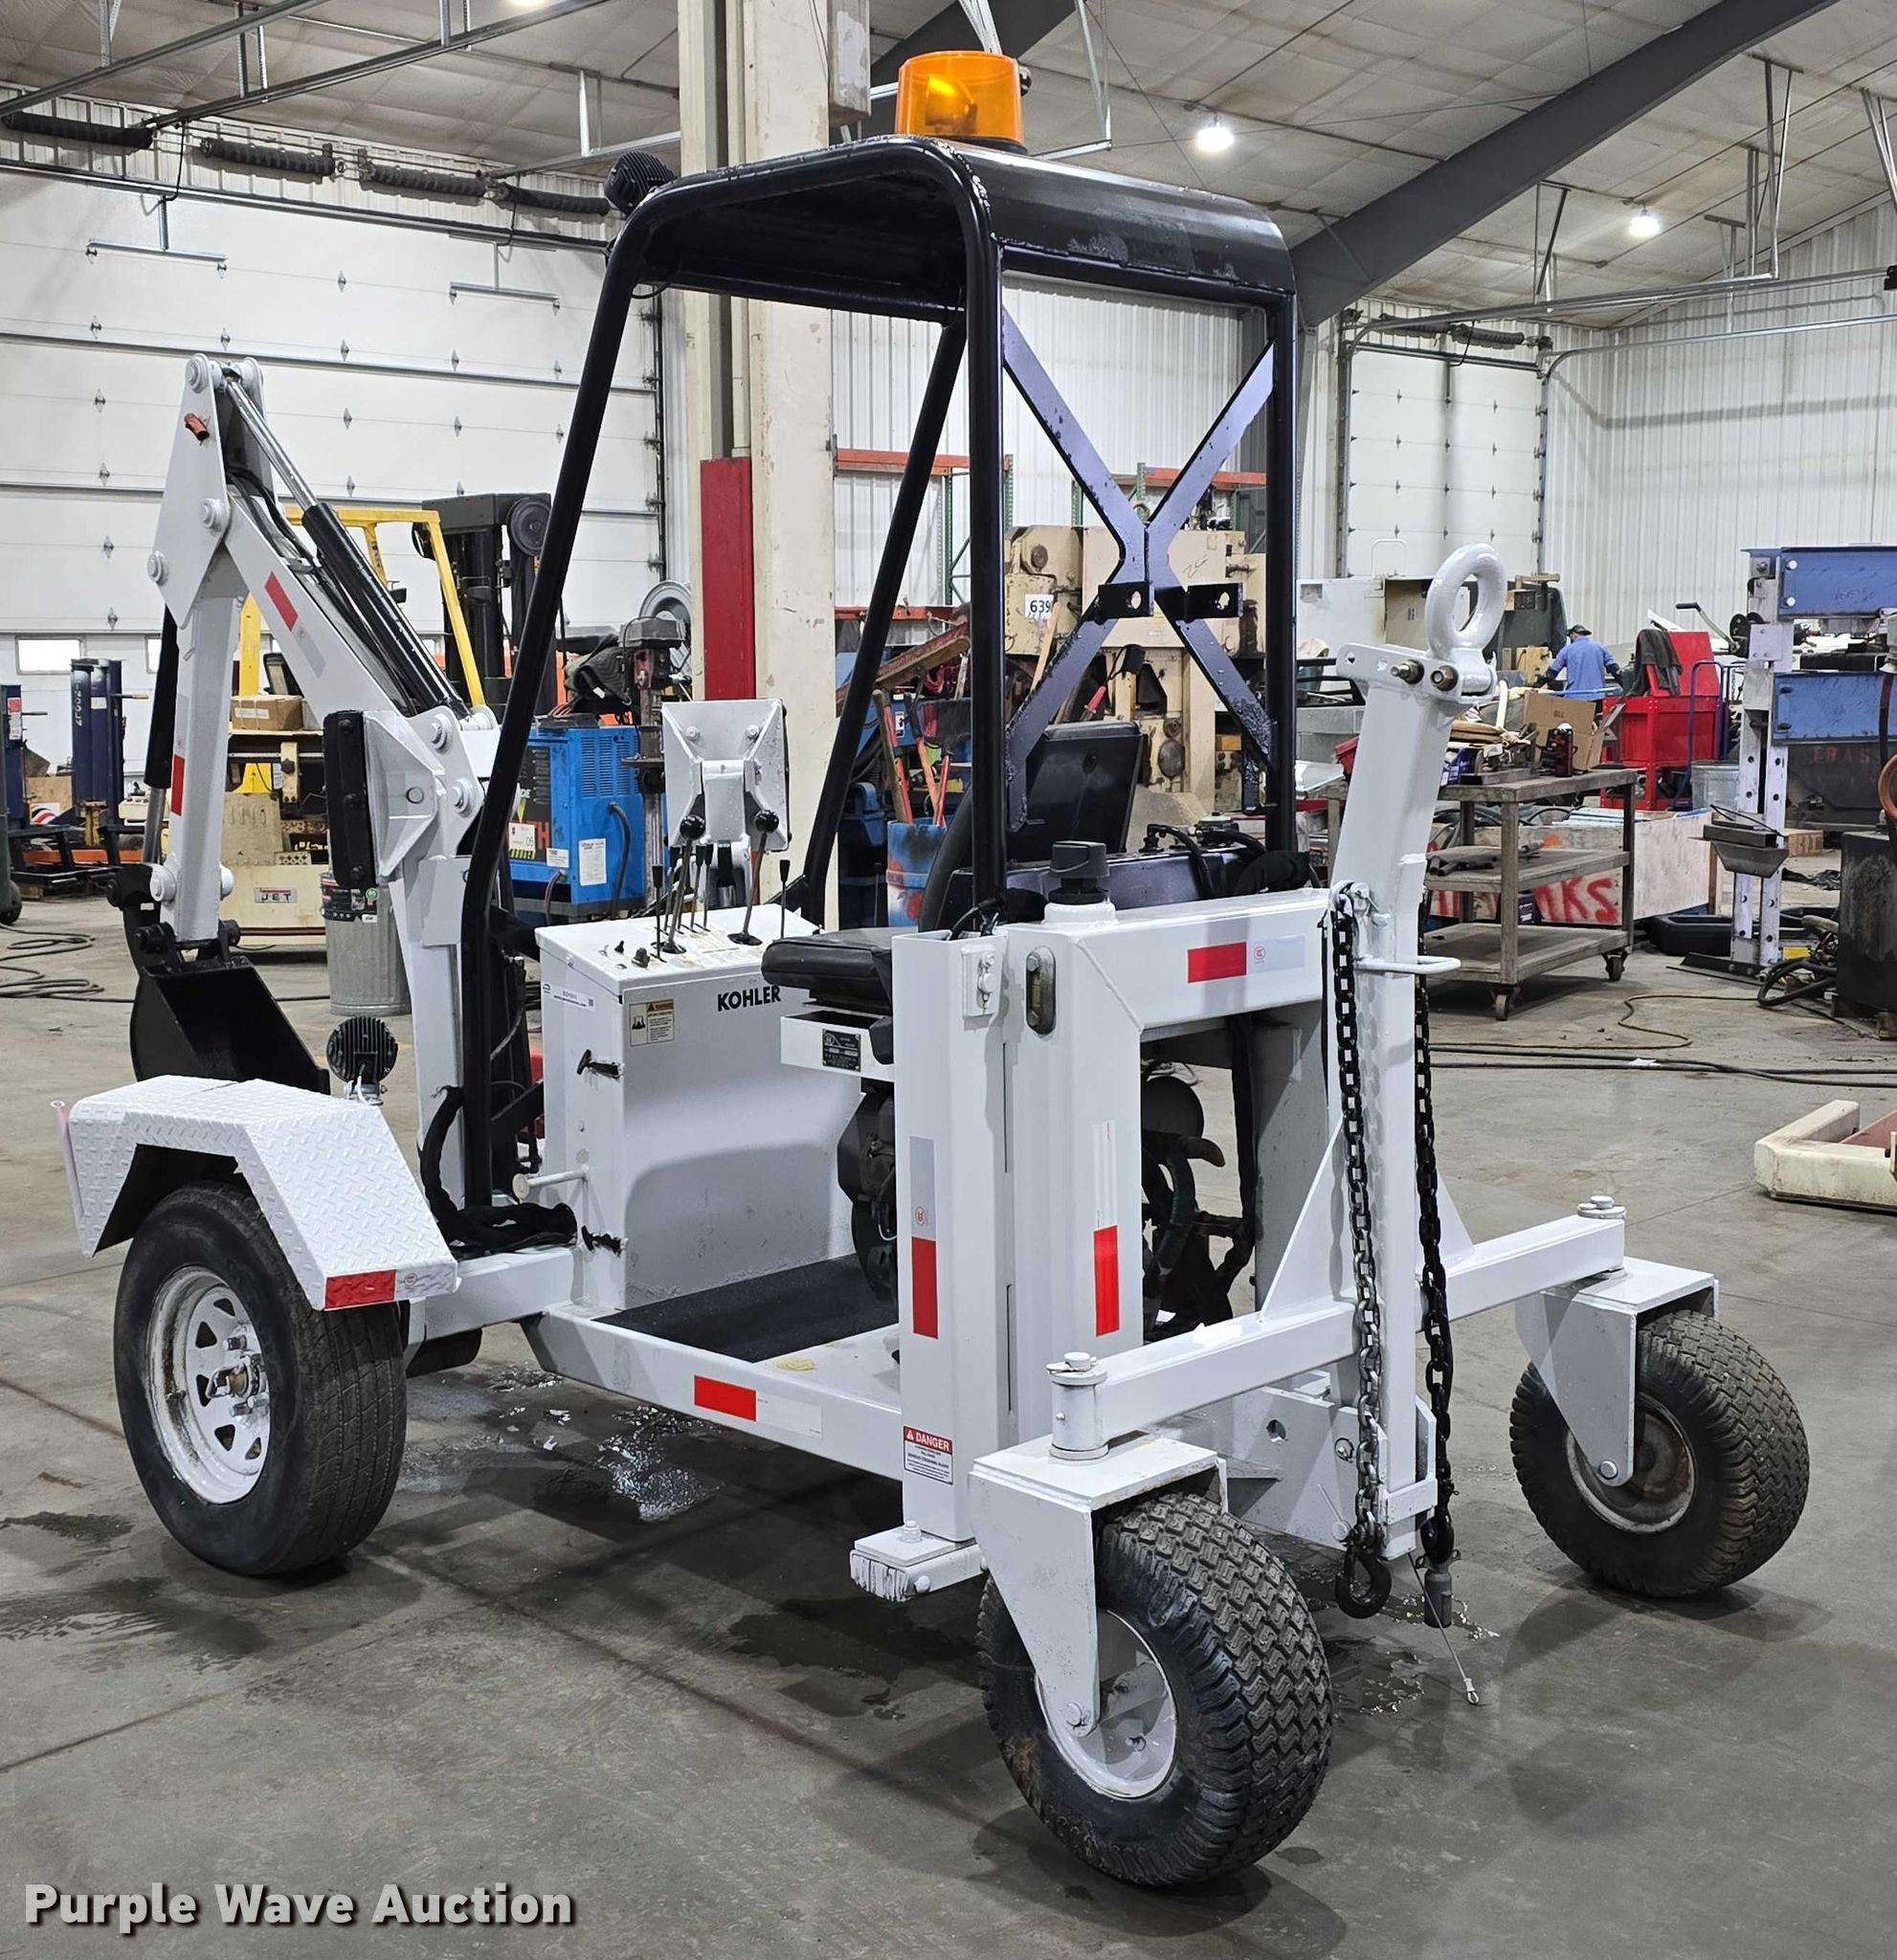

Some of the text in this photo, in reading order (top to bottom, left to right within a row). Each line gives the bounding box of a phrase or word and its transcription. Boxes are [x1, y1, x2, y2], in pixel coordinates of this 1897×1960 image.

[260, 893, 292, 902] JET
[718, 985, 781, 1012] KOHLER
[916, 1432, 949, 1452] DANGER
